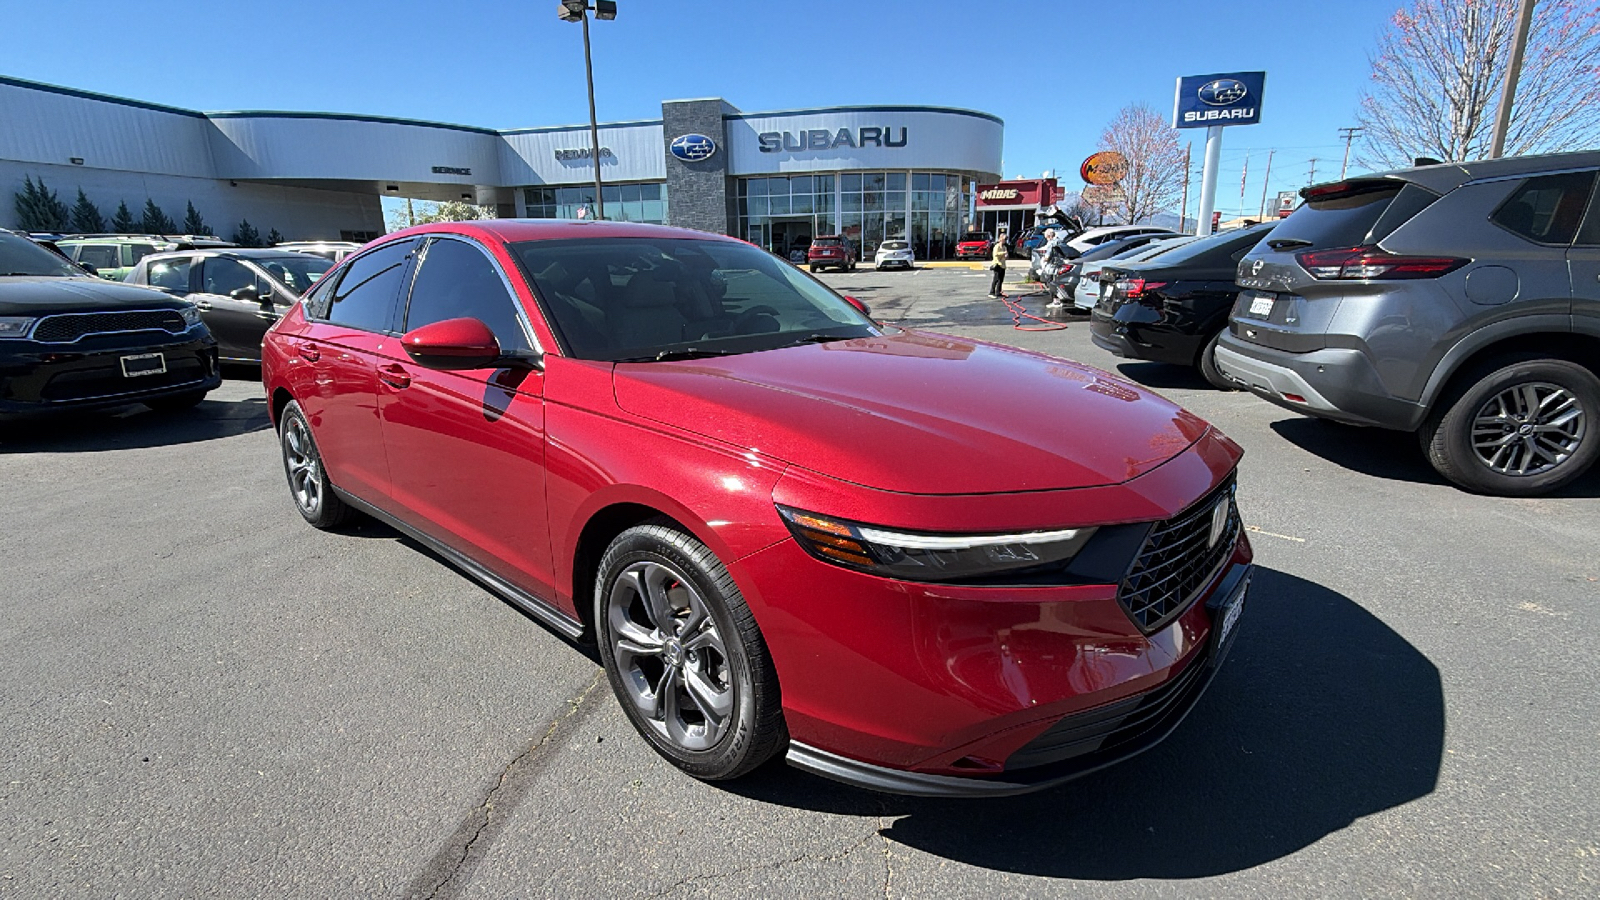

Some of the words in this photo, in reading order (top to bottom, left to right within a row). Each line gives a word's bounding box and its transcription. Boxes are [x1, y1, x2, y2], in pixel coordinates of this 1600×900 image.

[1184, 108, 1254, 122] SUBARU
[758, 126, 908, 153] SUBARU
[431, 166, 472, 175] SERVICE
